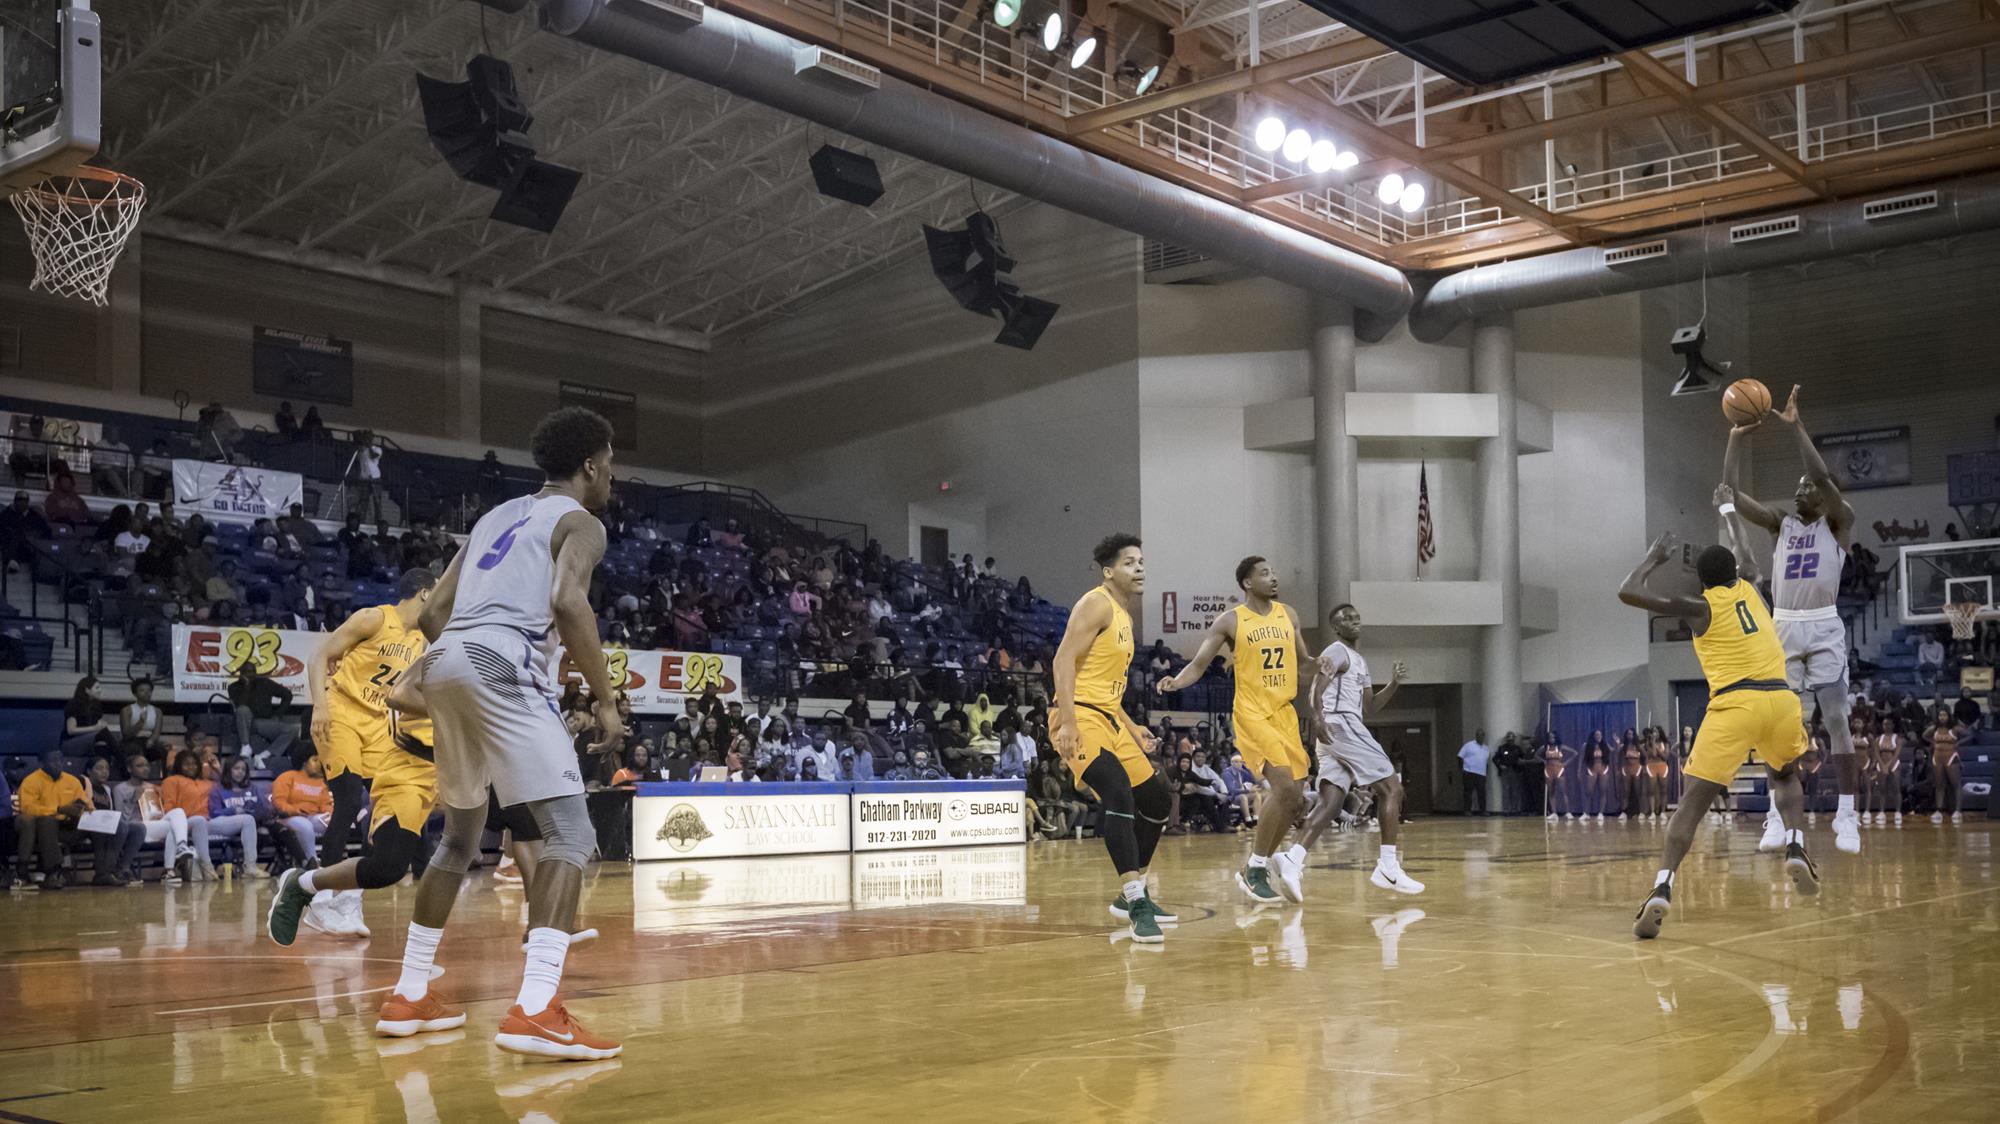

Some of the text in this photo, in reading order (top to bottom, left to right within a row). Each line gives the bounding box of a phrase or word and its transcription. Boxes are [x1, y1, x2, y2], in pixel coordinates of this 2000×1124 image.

[477, 516, 531, 571] 5
[1787, 534, 1816, 550] SSU
[1784, 552, 1820, 580] 22
[1192, 603, 1226, 612] ROAR
[1735, 600, 1758, 635] 0
[1181, 621, 1201, 630] The
[1247, 626, 1290, 646] NORFOLK
[186, 630, 282, 676] E93
[1261, 647, 1284, 670] 22
[659, 655, 723, 692] E93
[1262, 674, 1287, 688] STATE
[723, 804, 836, 829] SAVANNAH
[860, 800, 942, 823] Chatham Parkway
[970, 802, 1019, 815] SUBARU
[746, 830, 817, 846] LAW SCHOOL
[867, 829, 937, 843] 912-231-2020
[950, 826, 1020, 839] www.cpsubaru.com
